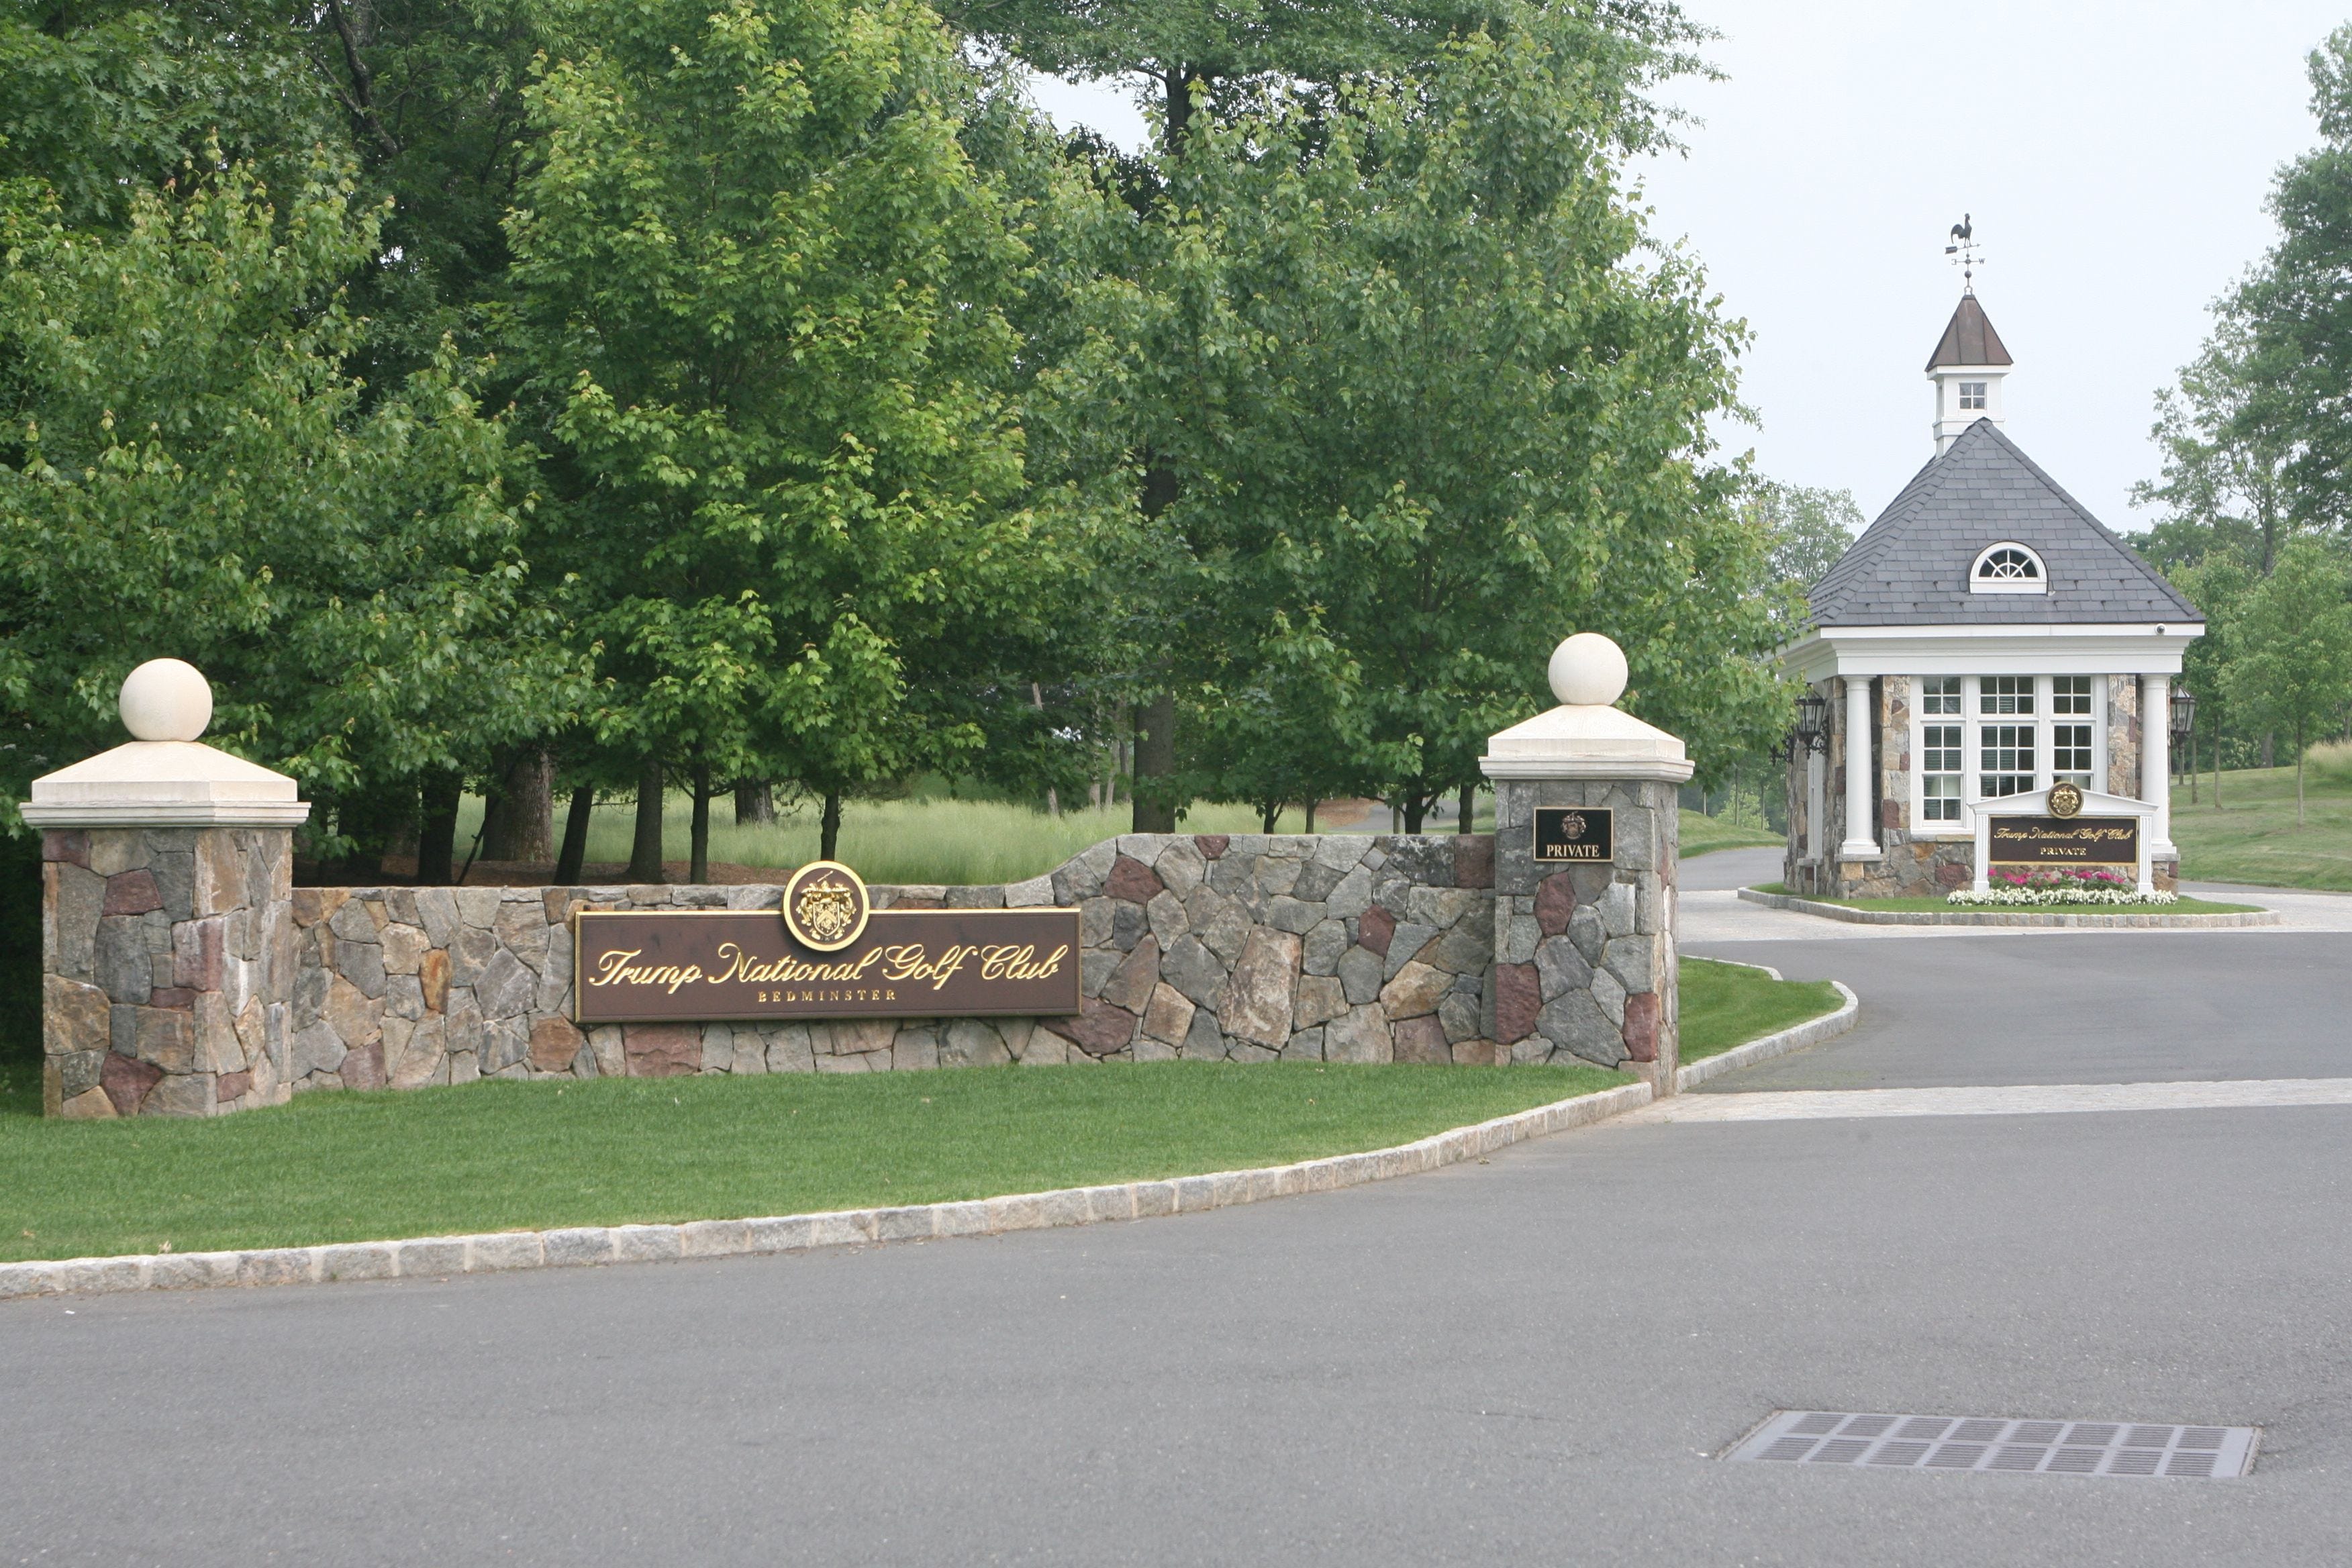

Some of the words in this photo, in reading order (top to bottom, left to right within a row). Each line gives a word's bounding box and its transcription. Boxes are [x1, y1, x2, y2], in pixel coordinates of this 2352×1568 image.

[1994, 828, 2028, 841] Trump
[2029, 826, 2079, 839] National
[2079, 828, 2108, 842] Golf
[2106, 828, 2133, 840] Club
[1546, 844, 1600, 857] PRIVATE
[2040, 846, 2087, 856] PRIVATE
[589, 949, 703, 994] Trump
[708, 942, 883, 984] National
[883, 944, 979, 991] Golf
[981, 944, 1069, 980] Club
[758, 989, 895, 1002] BEDMINSTER
